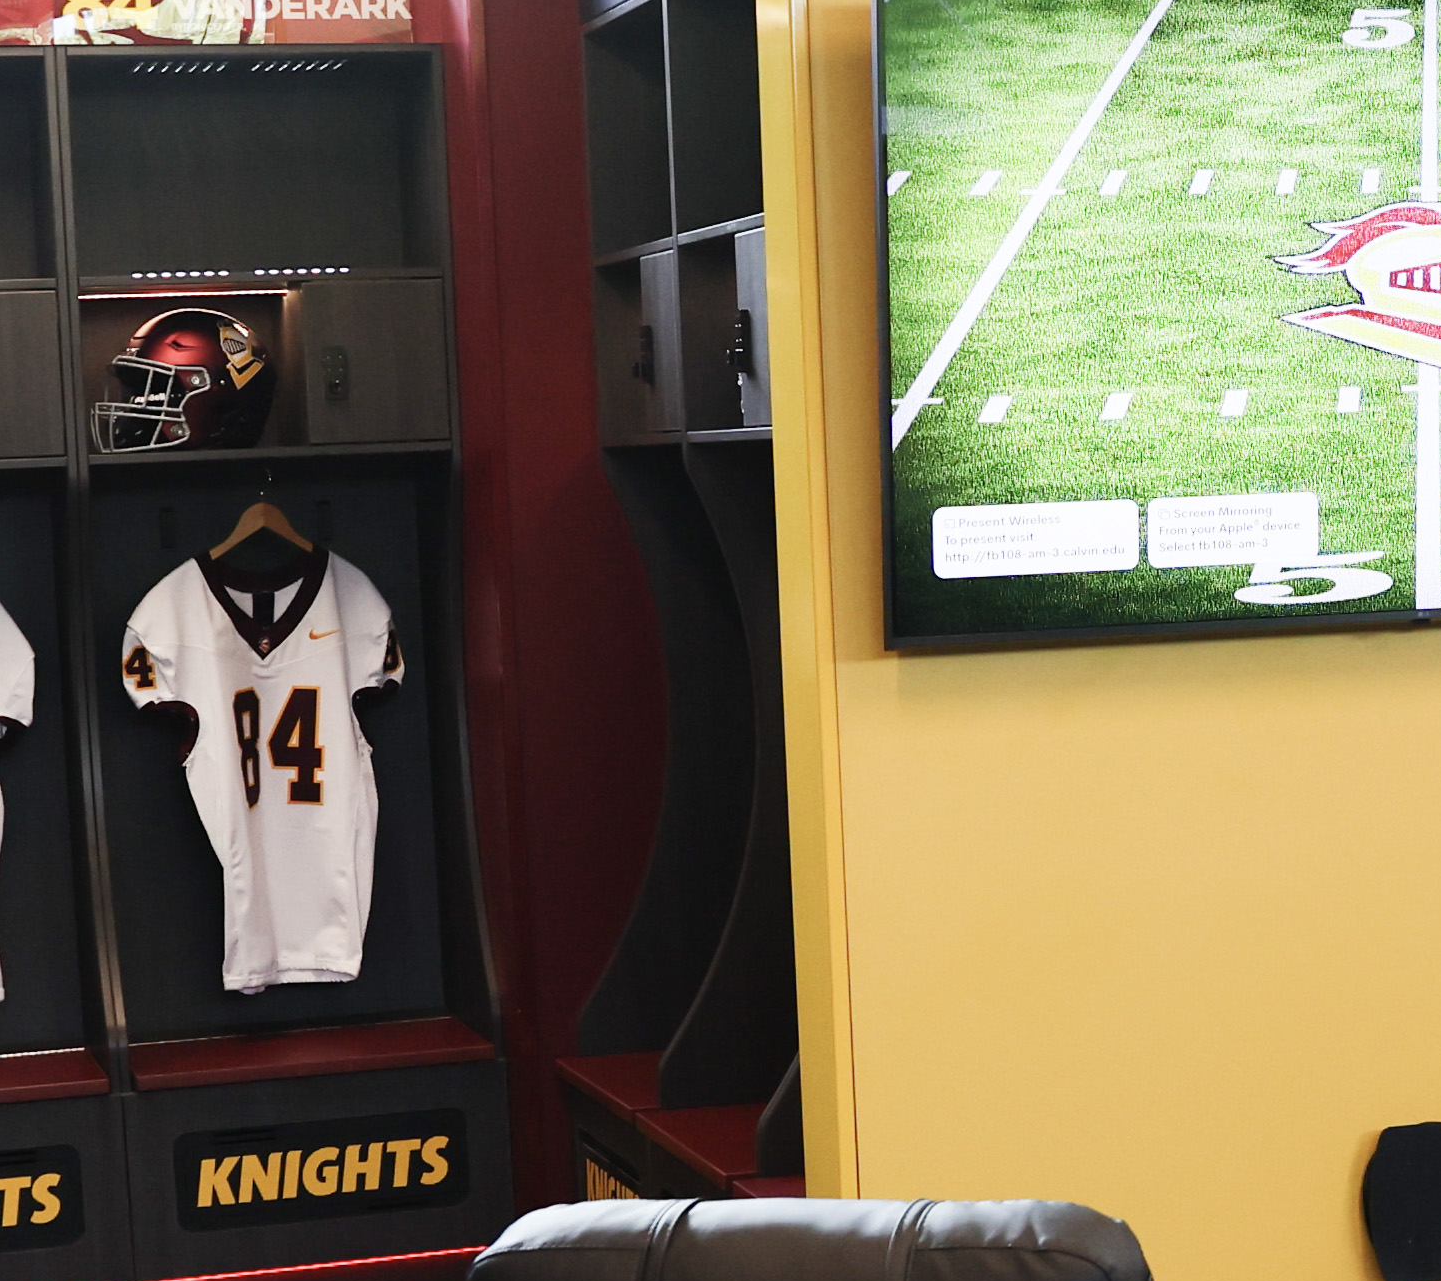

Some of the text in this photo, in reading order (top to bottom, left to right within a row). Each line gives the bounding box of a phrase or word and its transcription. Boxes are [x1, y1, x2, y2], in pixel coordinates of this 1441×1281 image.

[1174, 506, 1273, 518] Screen Mirroring
[959, 515, 1061, 528] Present Wireless
[1159, 525, 1187, 535] From
[1191, 526, 1215, 537] your
[1262, 521, 1300, 531] device
[945, 535, 957, 545] To
[960, 534, 1006, 547] present
[1159, 542, 1195, 552] Select
[123, 645, 157, 690] 4
[232, 684, 325, 811] 84
[196, 1135, 450, 1209] KNIGHTS
